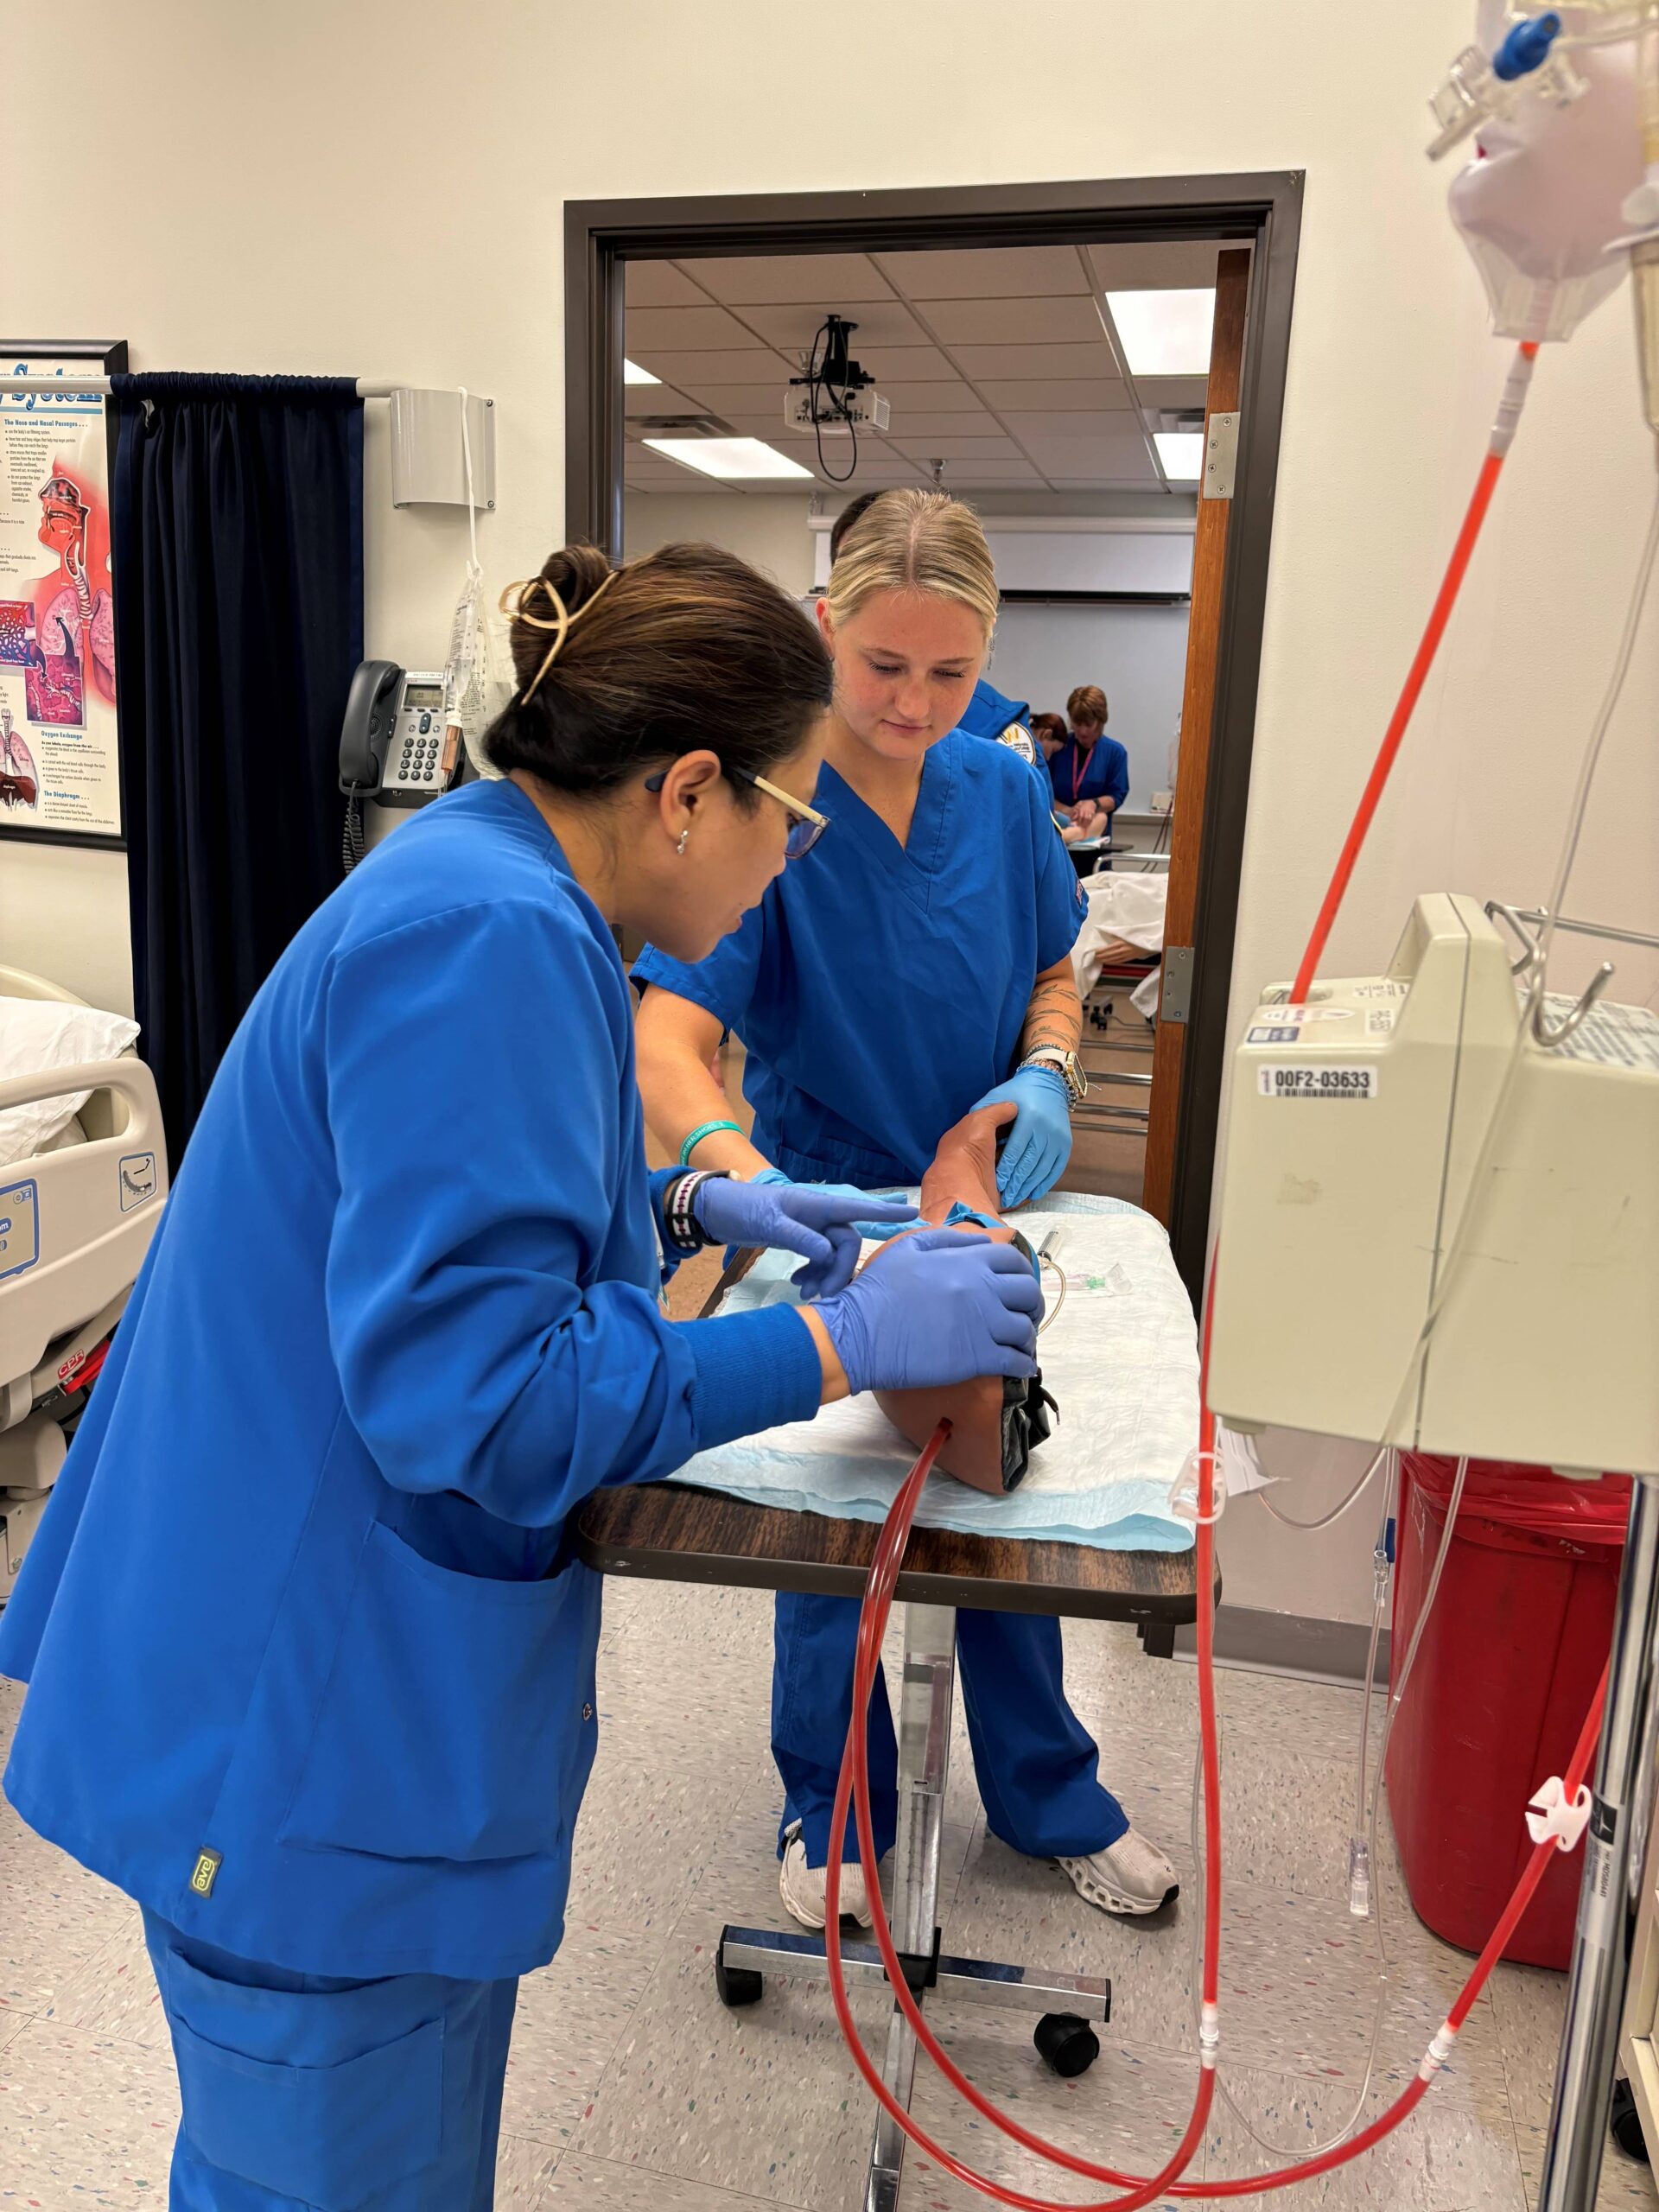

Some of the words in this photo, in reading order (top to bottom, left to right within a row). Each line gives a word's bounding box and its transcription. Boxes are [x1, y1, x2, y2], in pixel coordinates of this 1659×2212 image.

[60, 732, 83, 741] Exchange
[53, 791, 80, 800] Diaphragm
[1275, 1070, 1370, 1089] 00F2-03633
[59, 1349, 85, 1375] CPR
[197, 1860, 212, 1888] ave
